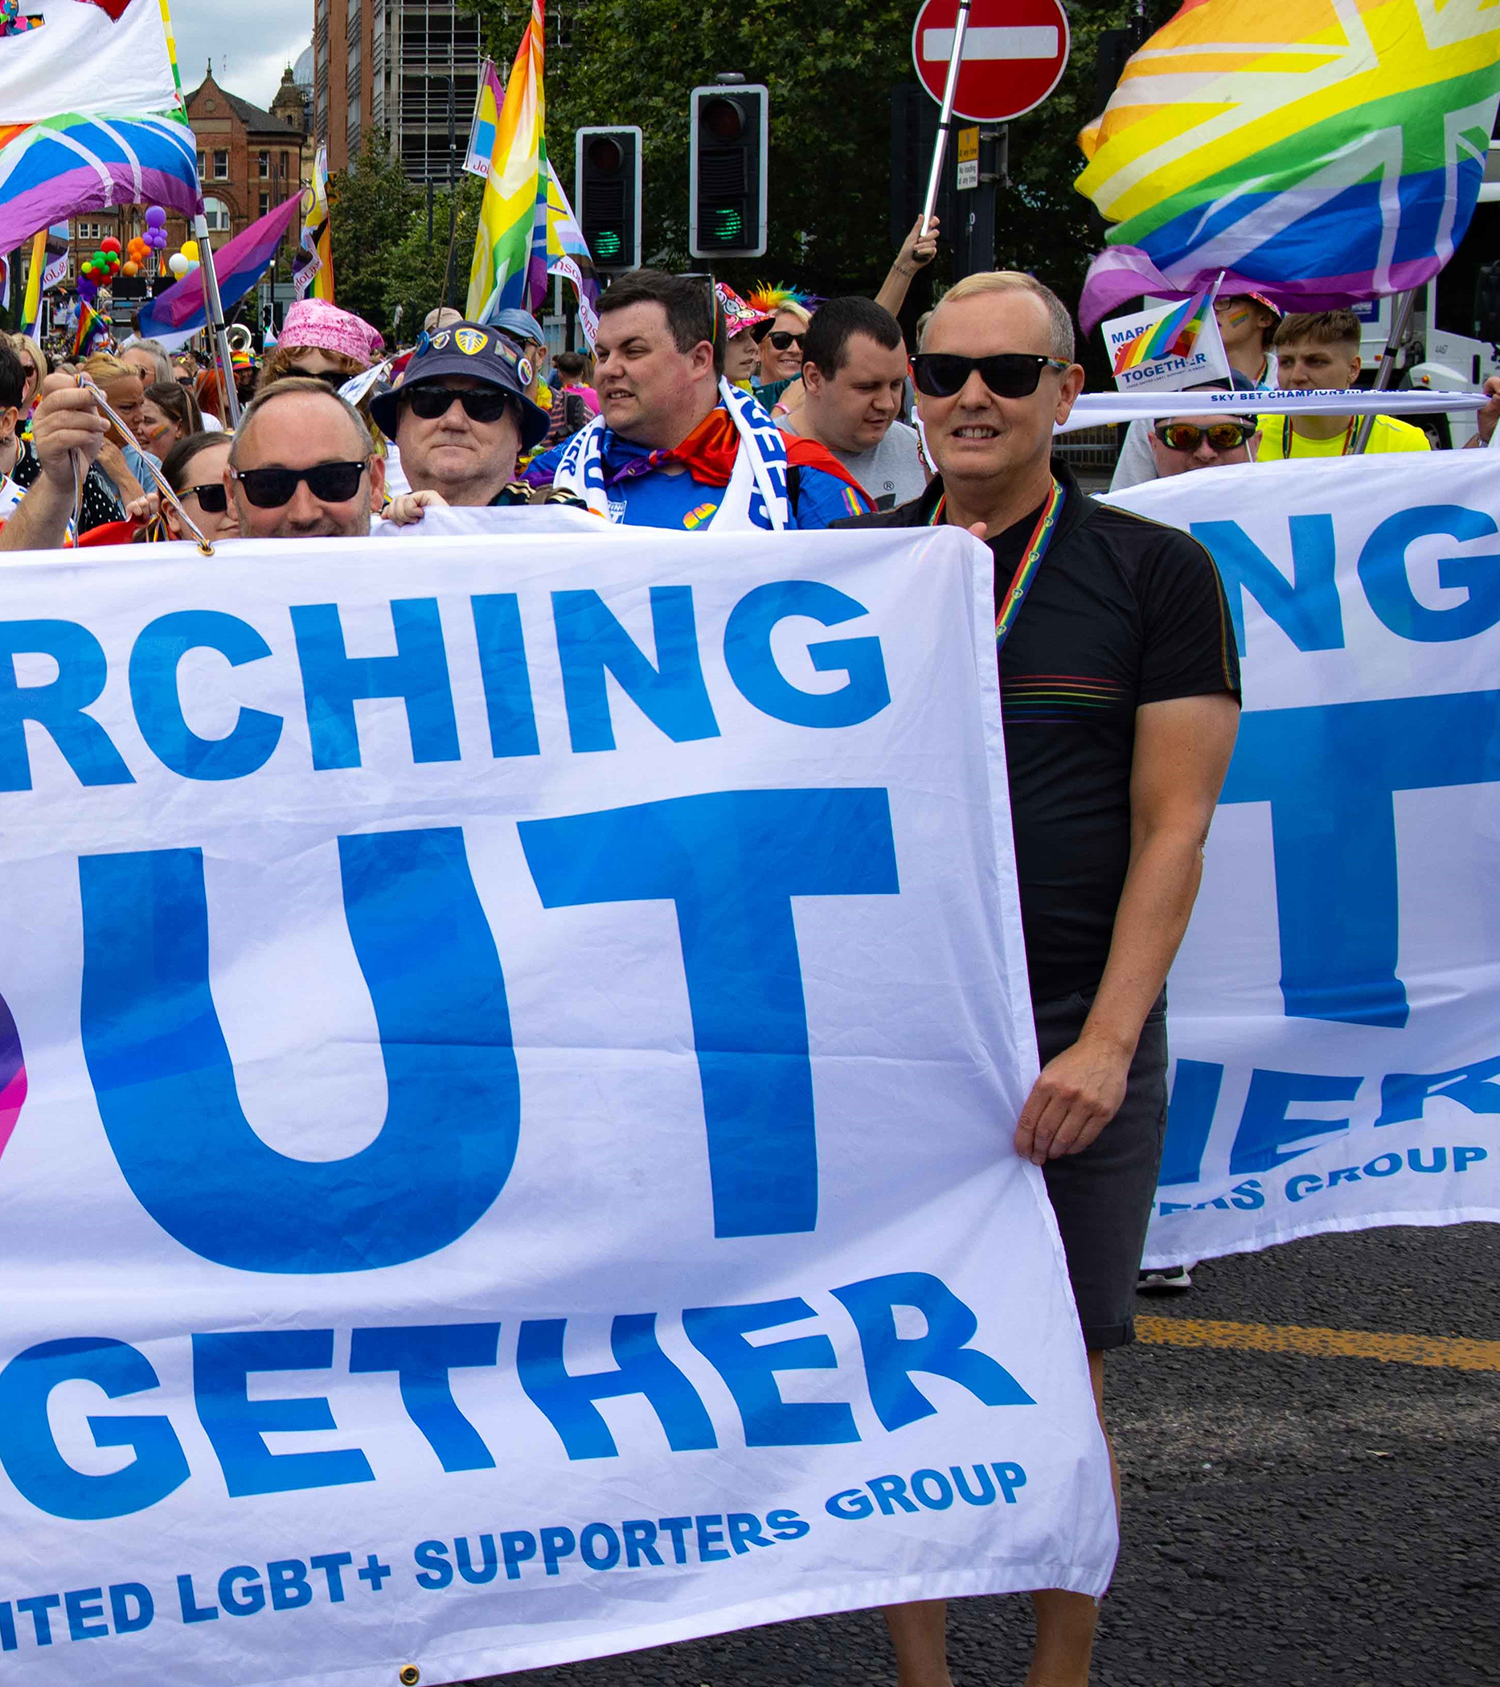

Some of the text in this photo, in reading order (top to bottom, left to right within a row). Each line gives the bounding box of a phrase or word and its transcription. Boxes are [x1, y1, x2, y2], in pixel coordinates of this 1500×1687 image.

[1121, 352, 1207, 383] TOGETHR
[1211, 394, 1235, 402] SKY
[1240, 392, 1263, 400] BET
[1189, 504, 1500, 658] NG
[1285, 1146, 1488, 1202] GROUP
[177, 1551, 391, 1623] LGBT+
[414, 1509, 810, 1590] SUPPORTERS
[825, 1461, 1028, 1521] GROUP
